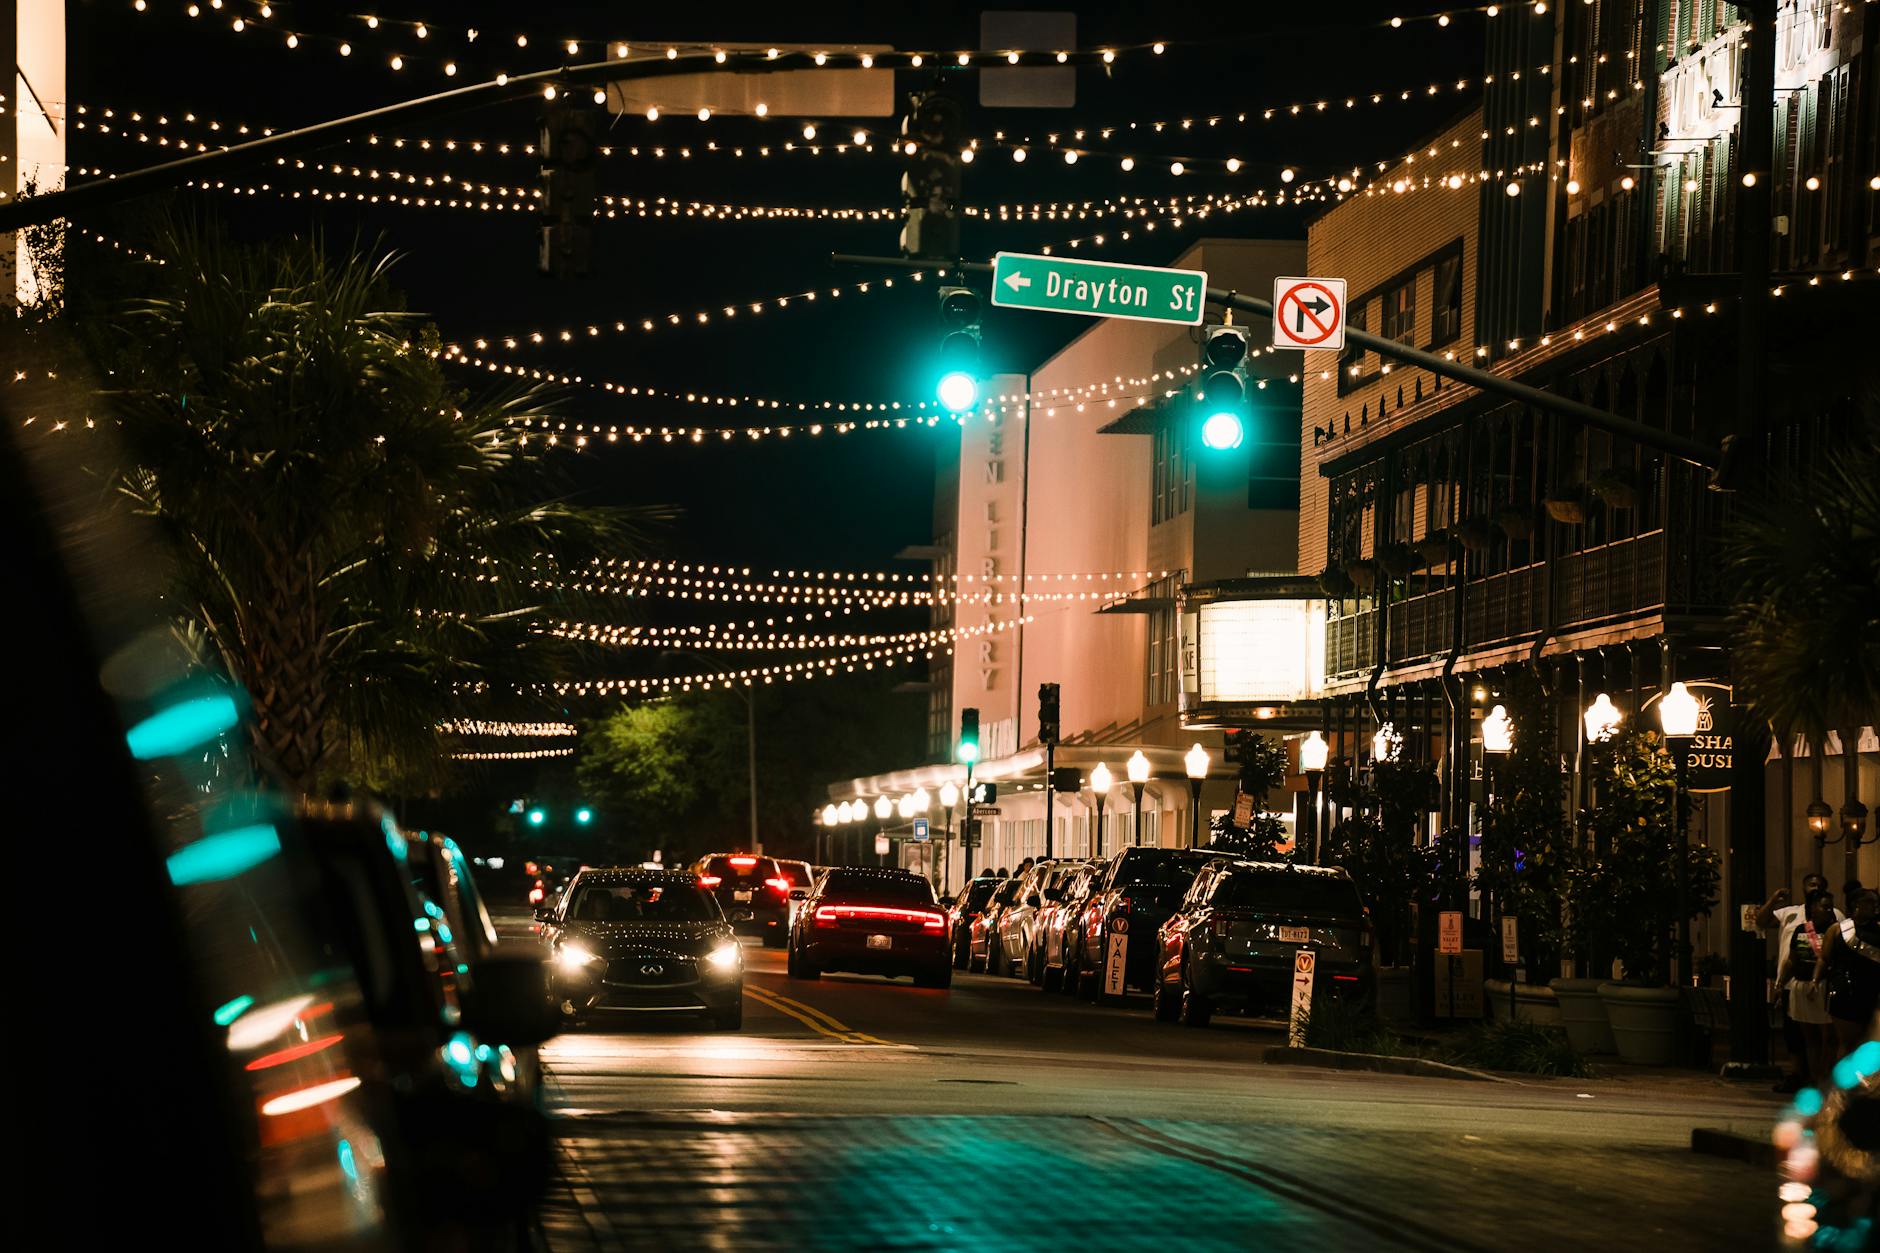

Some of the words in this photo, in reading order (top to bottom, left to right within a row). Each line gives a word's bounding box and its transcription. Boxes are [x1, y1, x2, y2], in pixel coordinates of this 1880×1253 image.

[1046, 271, 1148, 309] Drayton
[1169, 284, 1195, 312] St
[1111, 938, 1123, 990] VALET
